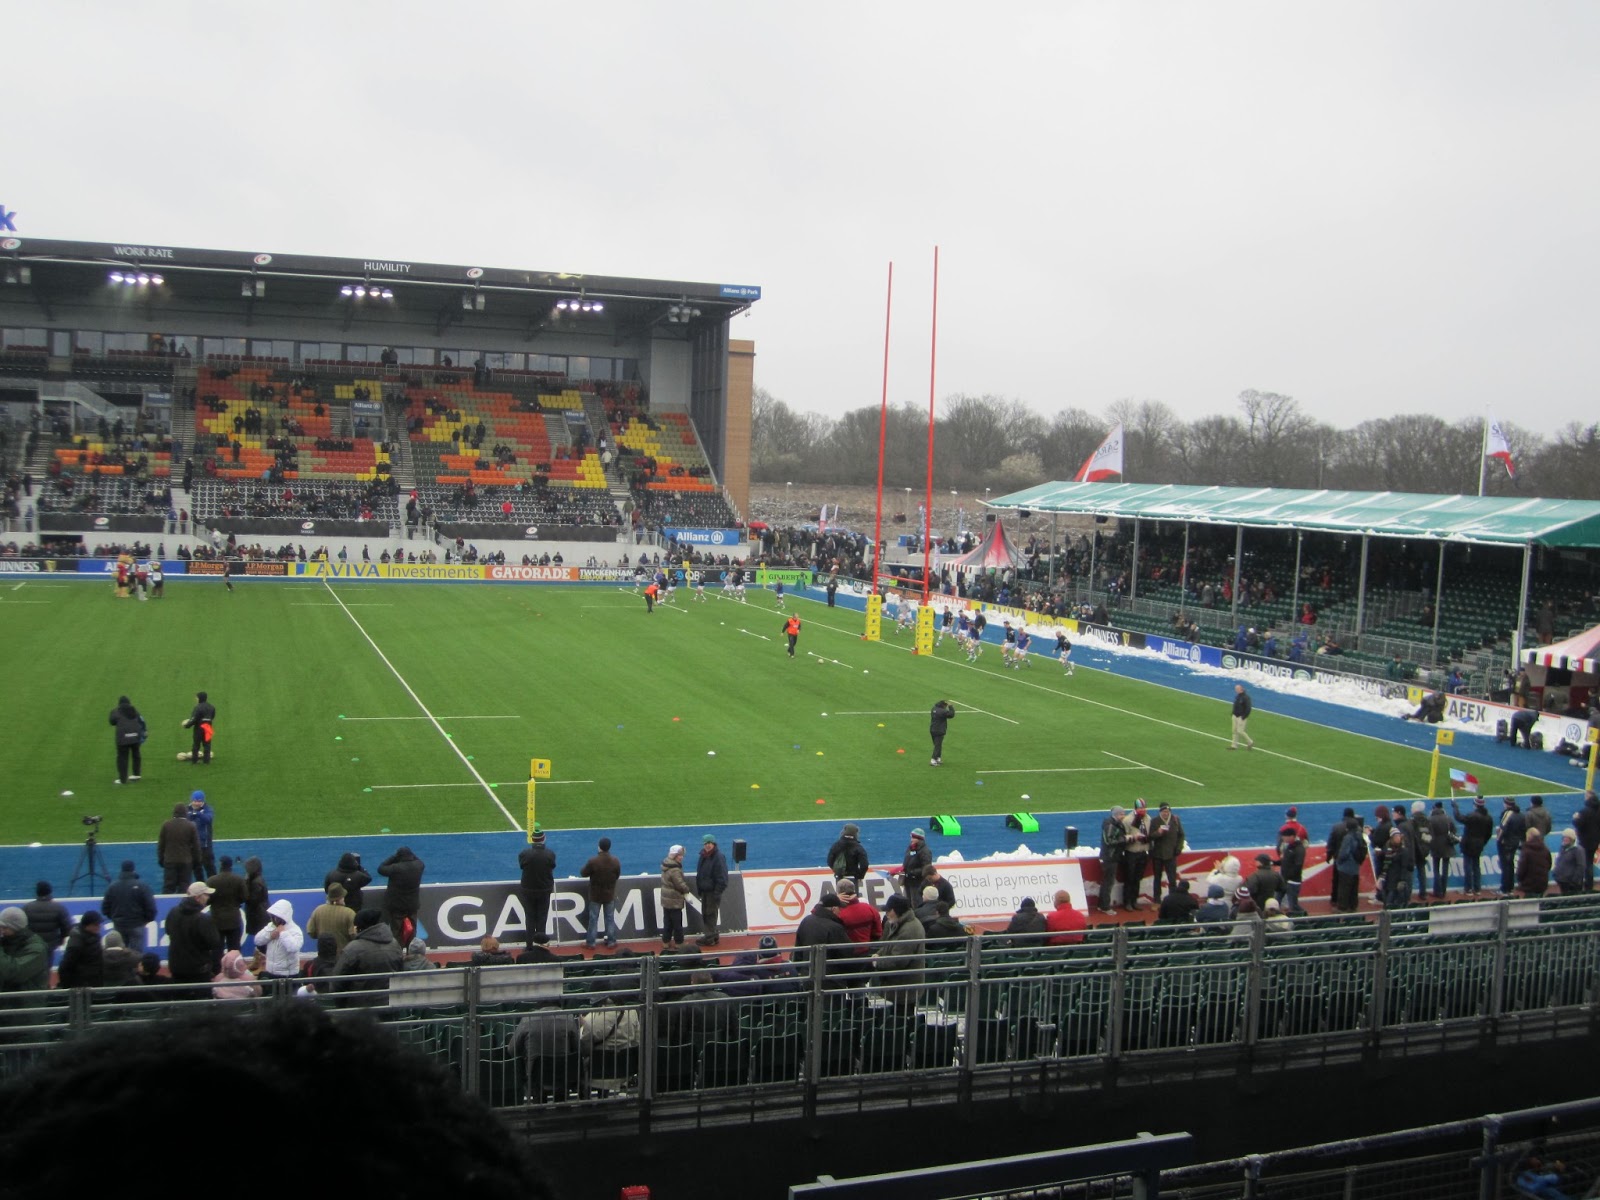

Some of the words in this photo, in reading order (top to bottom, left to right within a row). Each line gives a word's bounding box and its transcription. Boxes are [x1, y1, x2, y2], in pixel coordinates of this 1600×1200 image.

[113, 246, 146, 257] WORK
[148, 248, 174, 258] RATE
[364, 261, 411, 272] HUMILITY
[676, 531, 709, 542] Allianz
[315, 564, 380, 577] AVIVA
[387, 564, 479, 579] Investments
[492, 567, 570, 579] GATORADE
[1085, 625, 1119, 645] GUINNESS
[1162, 641, 1189, 659] Allianz
[1238, 658, 1261, 671] LAND
[1262, 662, 1292, 679] ROVER
[1448, 700, 1486, 722] AFEX
[948, 874, 991, 888] Global
[995, 871, 1058, 890] payments
[955, 892, 1008, 909] olutions
[1012, 890, 1055, 910] prvid
